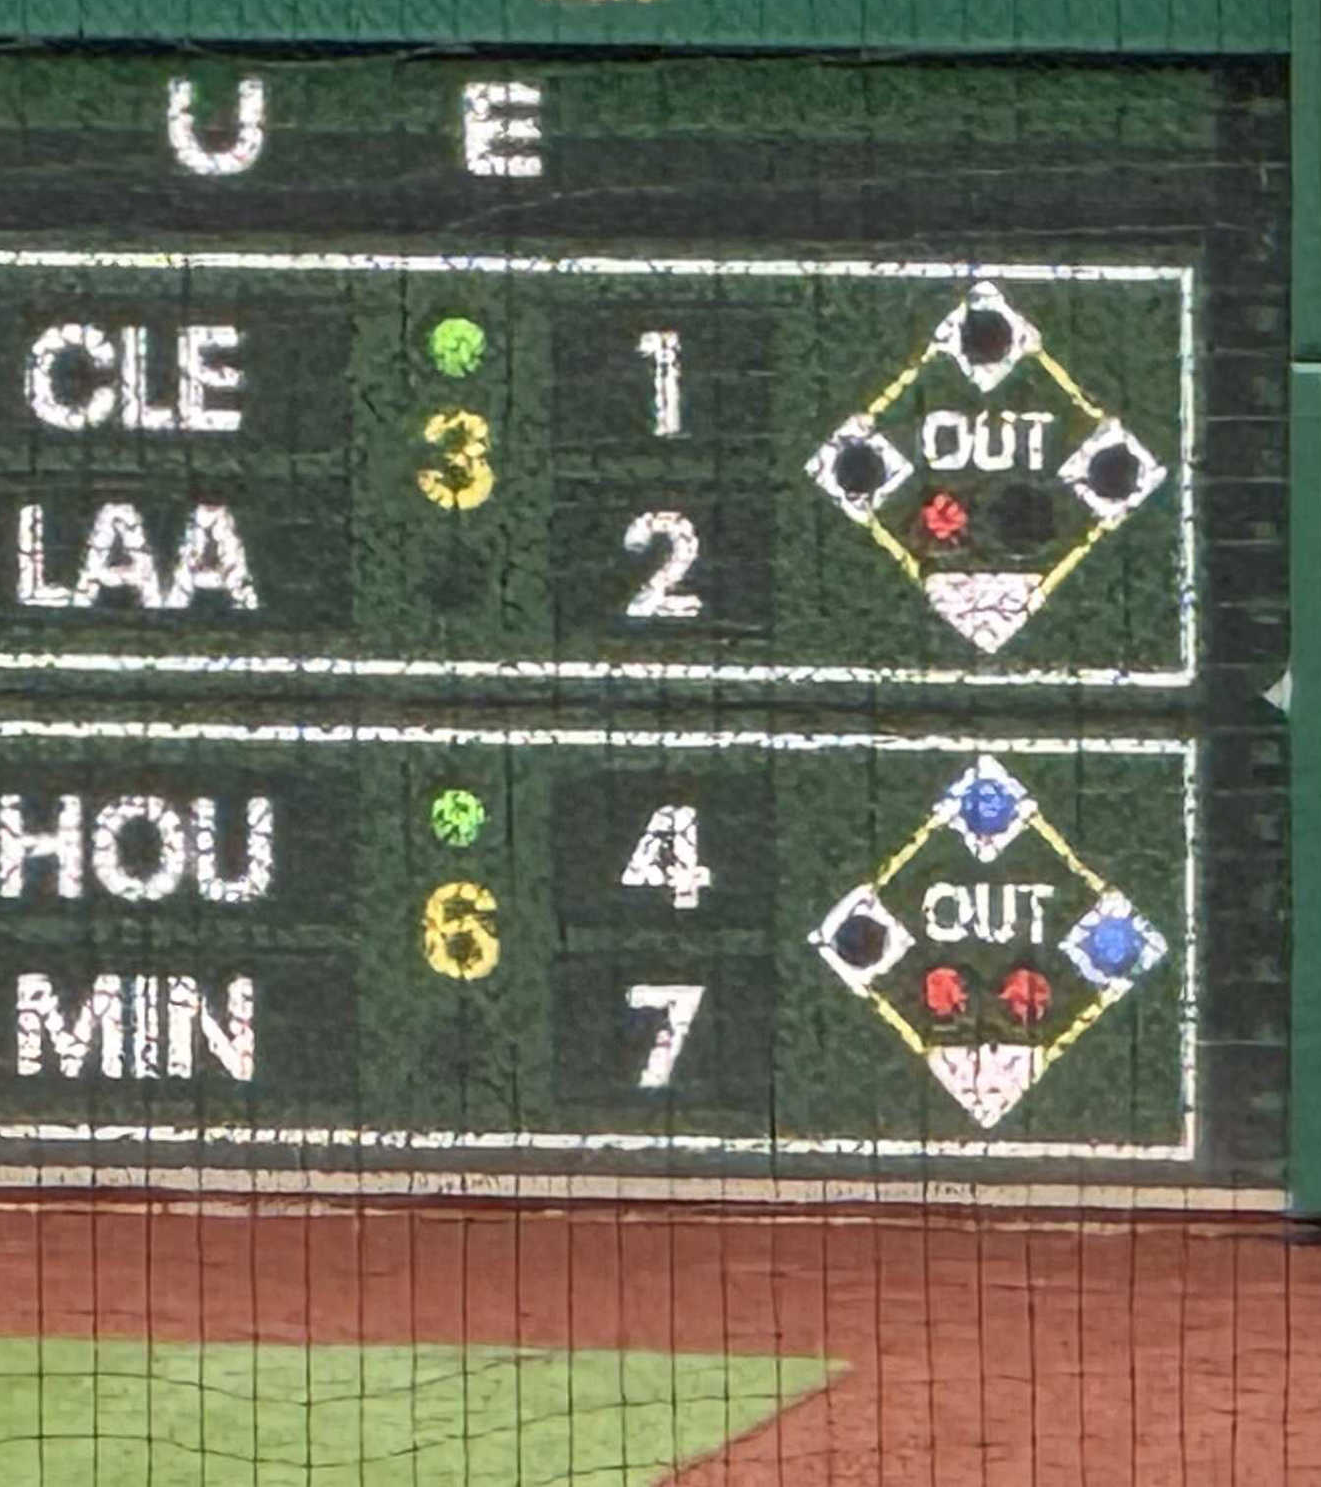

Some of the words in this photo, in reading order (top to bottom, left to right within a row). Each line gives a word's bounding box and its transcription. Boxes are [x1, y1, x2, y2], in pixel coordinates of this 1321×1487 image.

[24, 323, 243, 431] CLE
[637, 330, 682, 437] 1
[416, 409, 493, 511] 3
[922, 410, 1053, 471] OUT
[18, 502, 259, 609] LAA
[623, 512, 702, 617] 2
[621, 806, 711, 909] 4
[422, 881, 501, 981] 6
[921, 882, 1055, 944] OUT
[15, 973, 256, 1081] MIN
[626, 985, 706, 1088] 7
